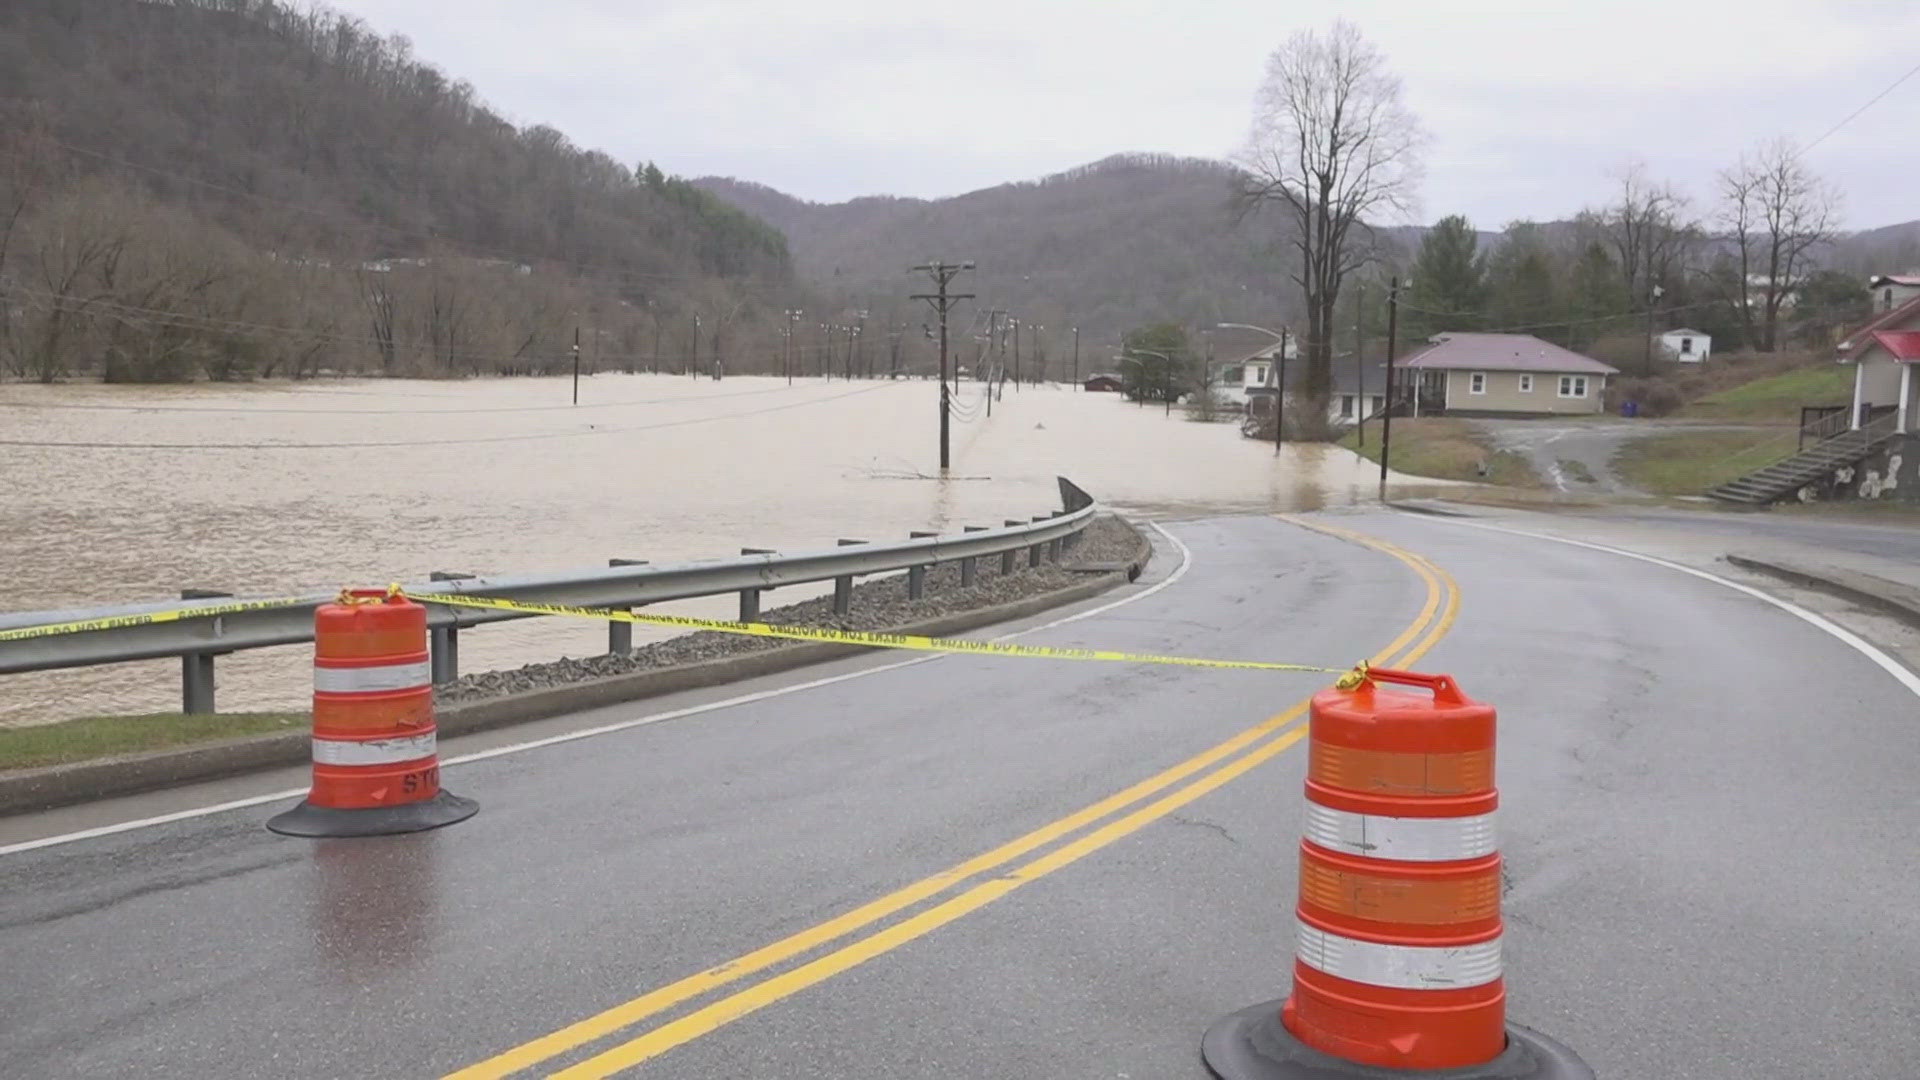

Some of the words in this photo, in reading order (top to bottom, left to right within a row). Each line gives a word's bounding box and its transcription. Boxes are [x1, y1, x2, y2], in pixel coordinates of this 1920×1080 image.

[178, 602, 238, 620] CAUTION
[241, 600, 260, 612] DO
[52, 623, 72, 636] DO
[108, 614, 153, 629] ENTER
